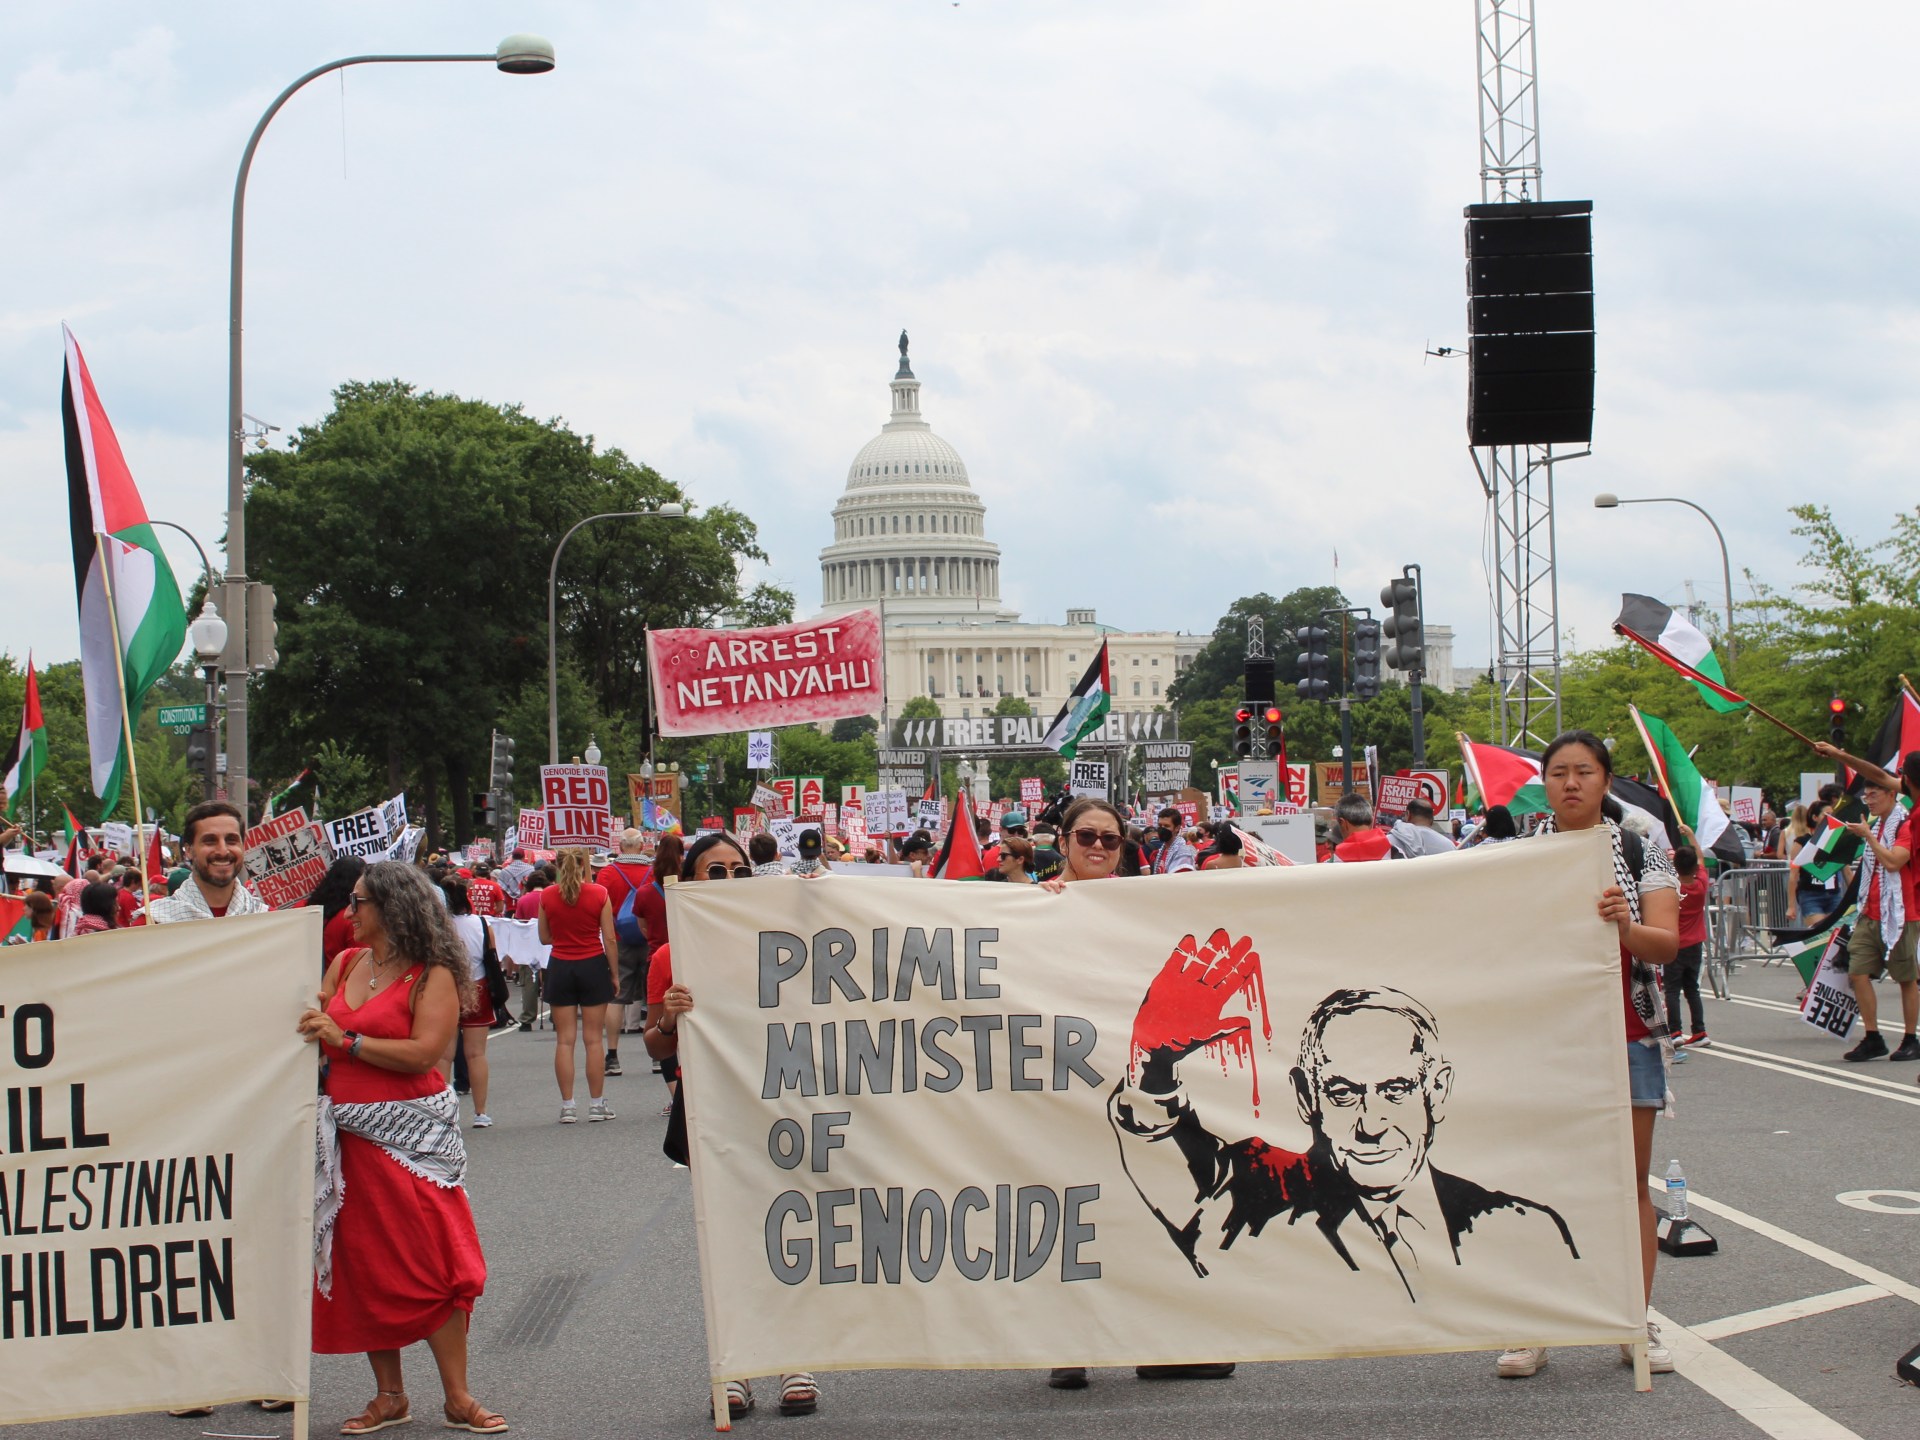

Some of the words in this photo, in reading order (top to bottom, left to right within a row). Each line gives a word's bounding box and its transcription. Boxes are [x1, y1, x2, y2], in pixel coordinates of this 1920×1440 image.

[705, 627, 840, 670] ARREST
[677, 660, 870, 710] NETANYAHU
[160, 708, 197, 724] CONSTITUTION
[174, 725, 190, 735] 300
[942, 718, 996, 746] FREE
[1001, 713, 1125, 744] PALNE!
[878, 751, 925, 764] WANTED
[1145, 743, 1191, 759] WANTED
[543, 767, 581, 776] GENOCIDE
[583, 768, 590, 776] IS
[592, 769, 606, 777] OUR
[894, 768, 925, 777] CRIMINAL
[1074, 763, 1105, 780] FREE
[1145, 763, 1160, 771] WAR
[1161, 762, 1190, 770] CRIMINAL
[1326, 766, 1369, 782] WATE
[1146, 769, 1190, 782] BENJAMIN
[1399, 779, 1419, 788] ARMING
[544, 777, 608, 806] RED
[1022, 787, 1041, 796] GAZA
[1072, 779, 1107, 790] PALESTINE
[1382, 785, 1417, 799] ISRAEL
[920, 801, 940, 811] FREE
[1244, 804, 1259, 812] THRU
[1380, 803, 1407, 812] COMMUNIT
[1386, 796, 1401, 804] FUND
[866, 806, 887, 815] RED
[889, 805, 905, 814] LINE
[1275, 806, 1297, 815] RED
[332, 812, 380, 845] FREE
[519, 814, 544, 830] RED
[547, 809, 610, 839] LINE
[848, 818, 863, 827] END
[867, 822, 883, 833] WE
[519, 831, 543, 845] LINE
[775, 824, 793, 838] END
[784, 833, 798, 843] the
[848, 826, 864, 835] U.S.
[332, 836, 389, 860] PALESTINE
[254, 868, 276, 882] WAR
[276, 851, 321, 872] CRIMINAL
[256, 855, 327, 896] BENJAMIN
[263, 873, 326, 908] NETANYAH
[758, 927, 1000, 1008] PRIME
[1806, 996, 1855, 1038] FREE
[0, 1003, 55, 1069] O
[761, 1015, 1105, 1099] MINISTER
[0, 1083, 110, 1154] ILL
[768, 1112, 851, 1172] OF
[765, 1184, 1101, 1285] GENOCIDE
[2, 1237, 235, 1340] HILDREN
